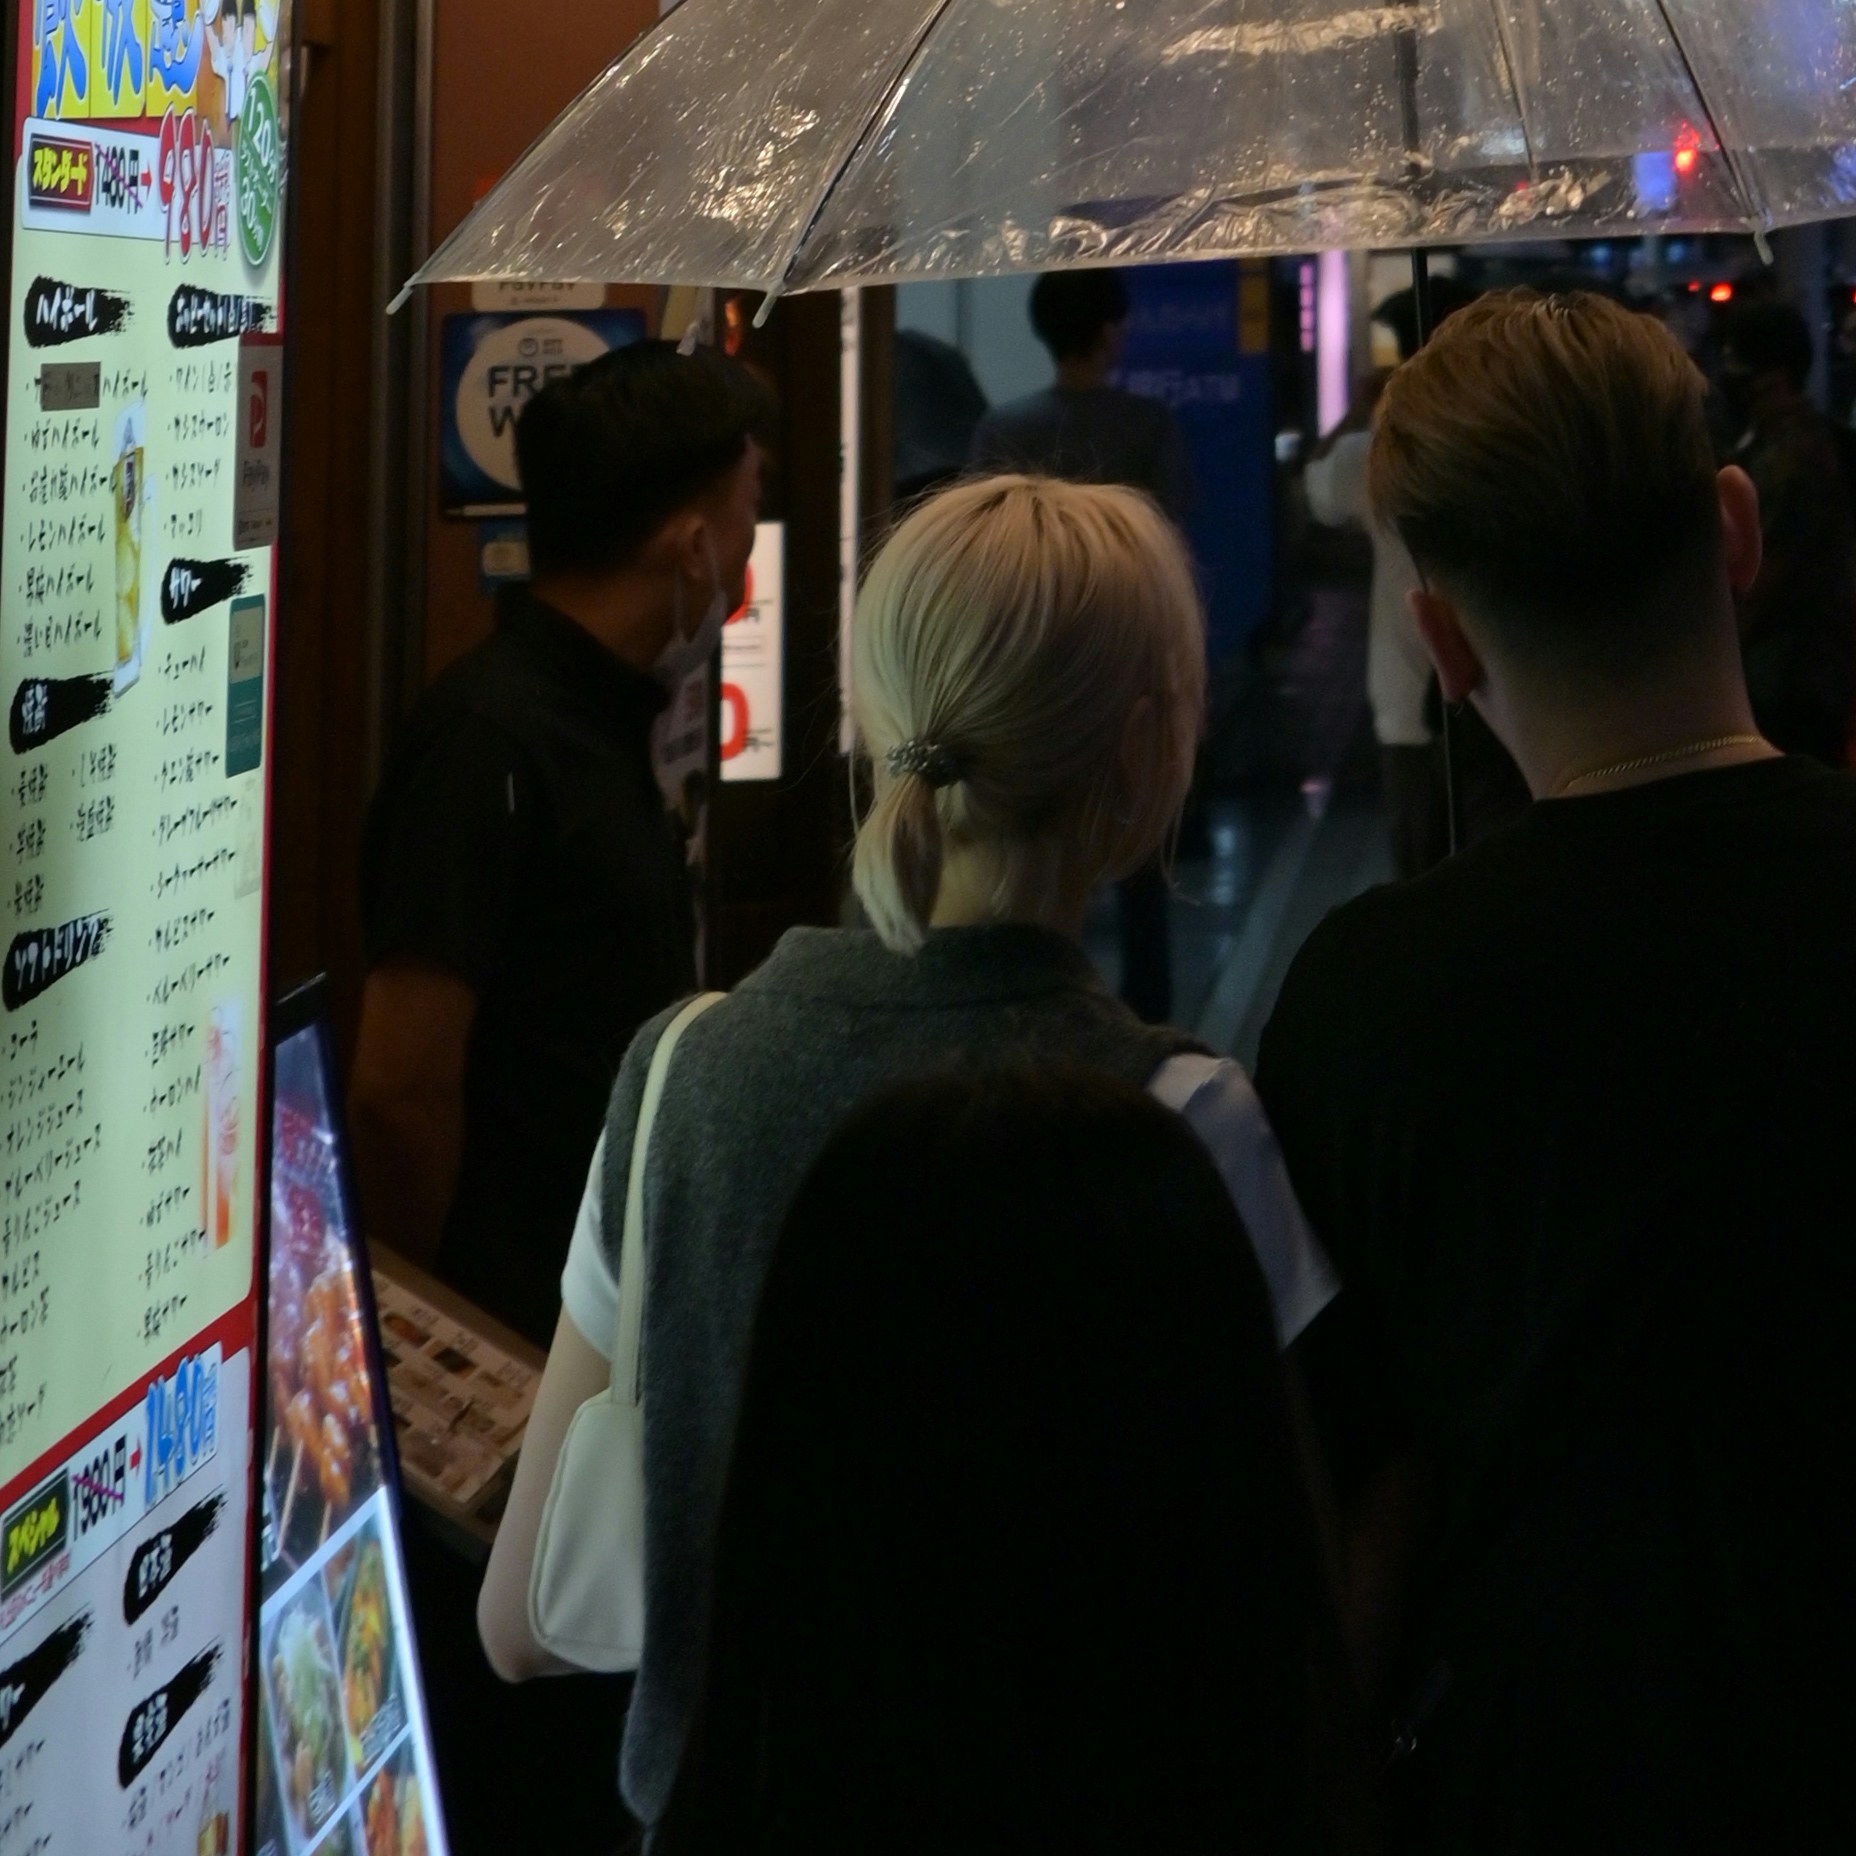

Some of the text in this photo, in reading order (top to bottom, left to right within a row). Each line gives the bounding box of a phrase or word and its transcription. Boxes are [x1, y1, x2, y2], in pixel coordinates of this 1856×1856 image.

[33, 146, 87, 196] スタンダード
[36, 286, 98, 332] ハイボール
[169, 567, 203, 609] サワー
[15, 913, 98, 992] ソフトドリンク
